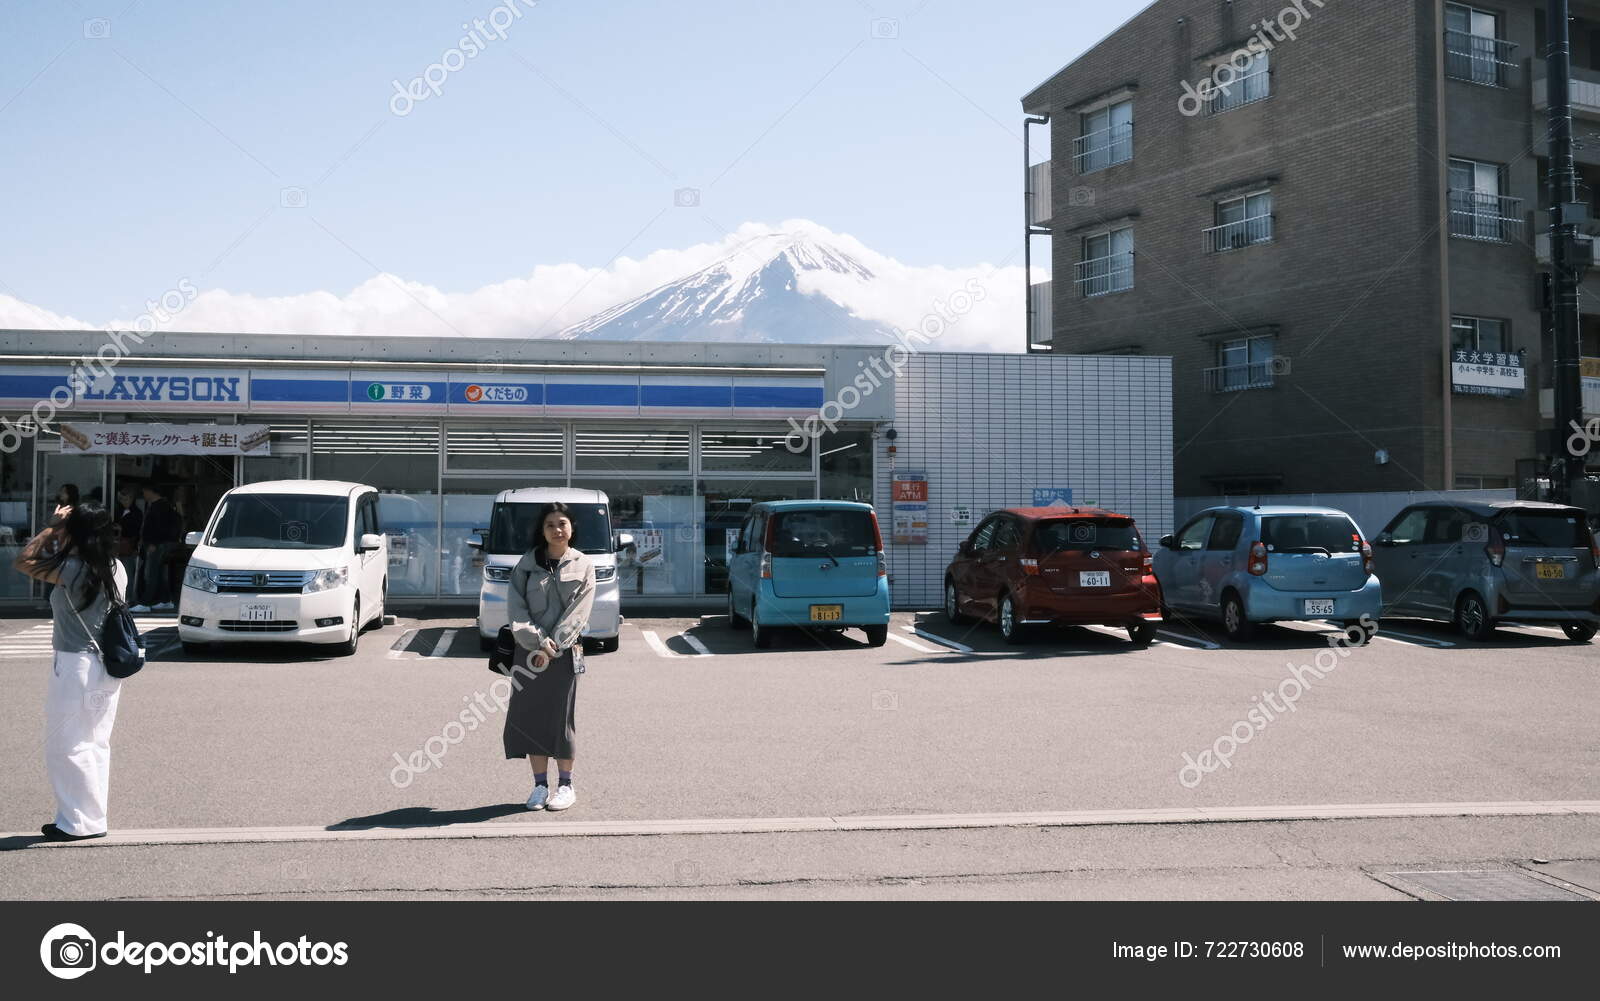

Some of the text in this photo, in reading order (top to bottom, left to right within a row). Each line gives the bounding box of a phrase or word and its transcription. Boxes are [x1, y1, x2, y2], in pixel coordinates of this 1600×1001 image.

[83, 375, 240, 402] LAWSON
[391, 386, 423, 399] 野菜
[484, 387, 525, 400] くだもの
[900, 491, 921, 500] ATM
[1087, 577, 1108, 586] 60-11
[1311, 605, 1333, 614] 55-65
[249, 610, 272, 620] 11-11
